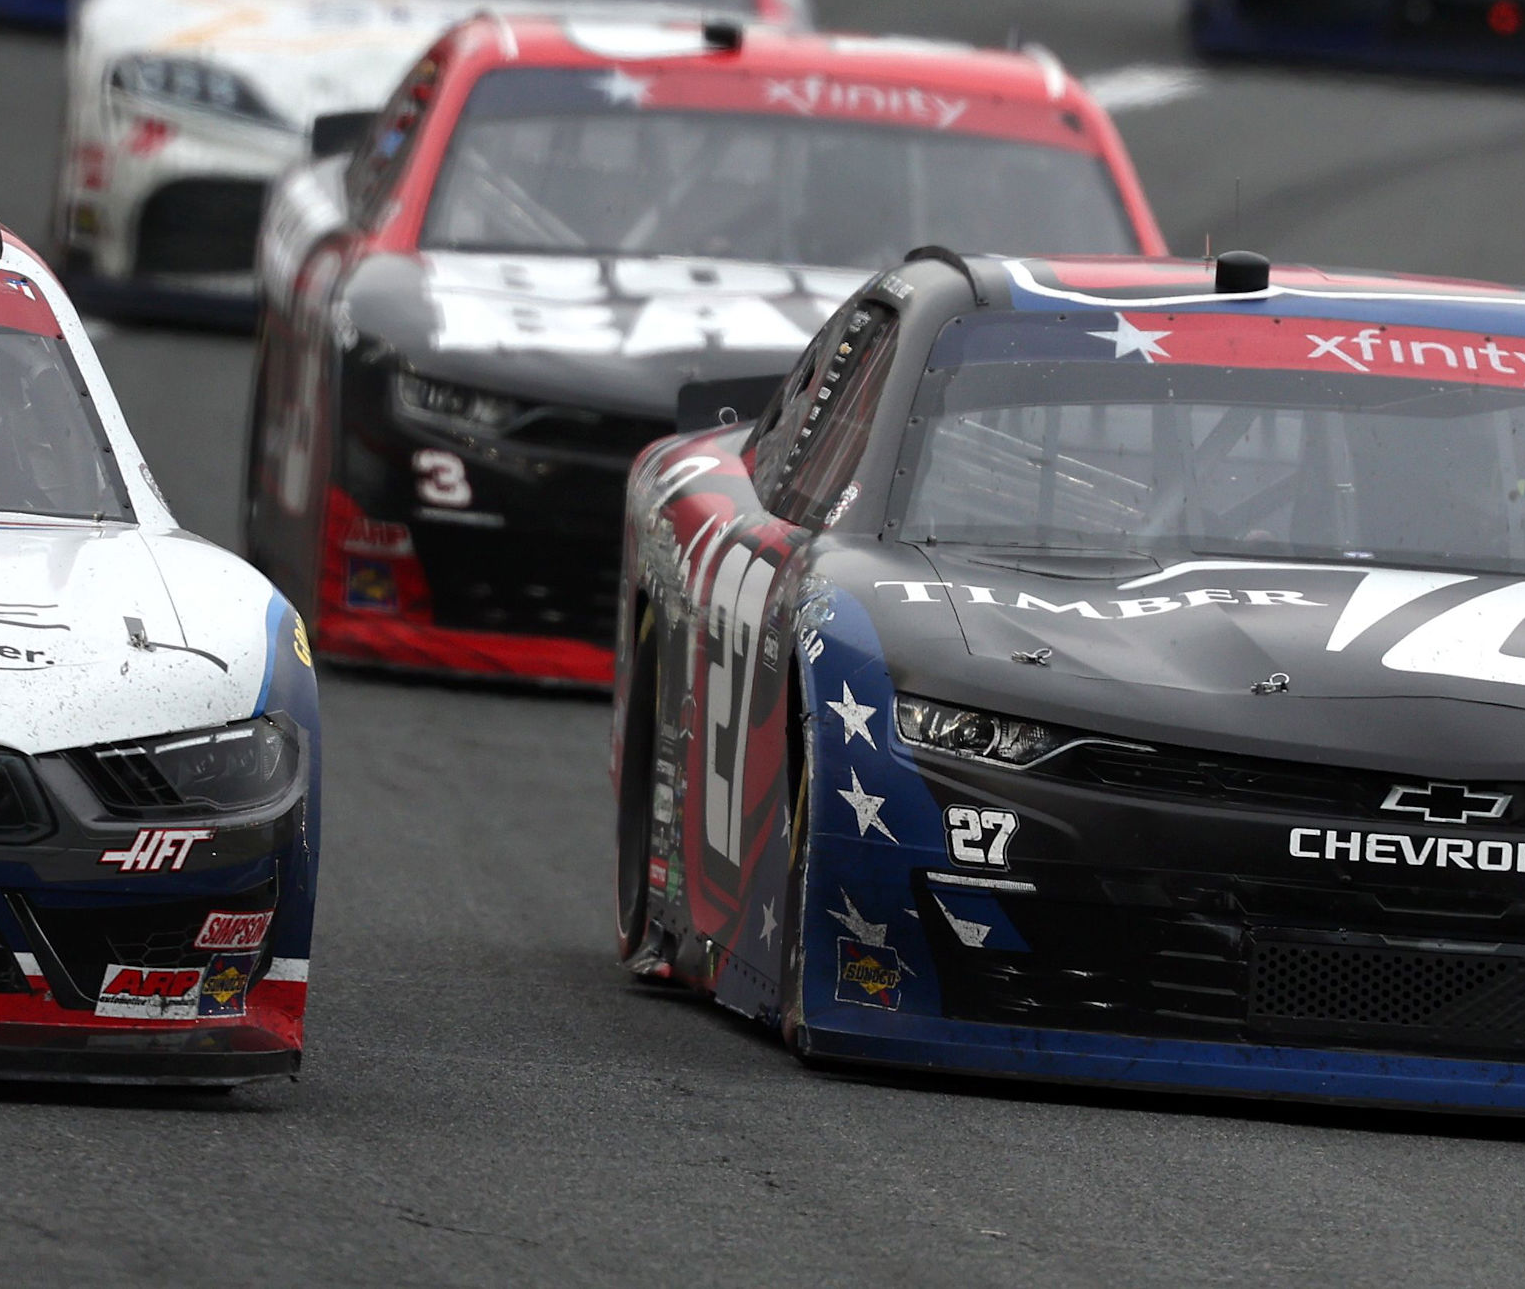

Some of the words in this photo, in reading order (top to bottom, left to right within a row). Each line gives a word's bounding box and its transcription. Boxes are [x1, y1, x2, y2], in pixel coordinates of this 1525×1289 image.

[763, 77, 967, 129] xfinity
[412, 449, 472, 509] 3
[874, 580, 1330, 621] TIMBER
[101, 828, 217, 872] HFT
[946, 808, 1018, 868] 27
[202, 915, 271, 946] SIMPSON
[102, 968, 201, 998] ARP
[845, 963, 901, 987] SUNOCO
